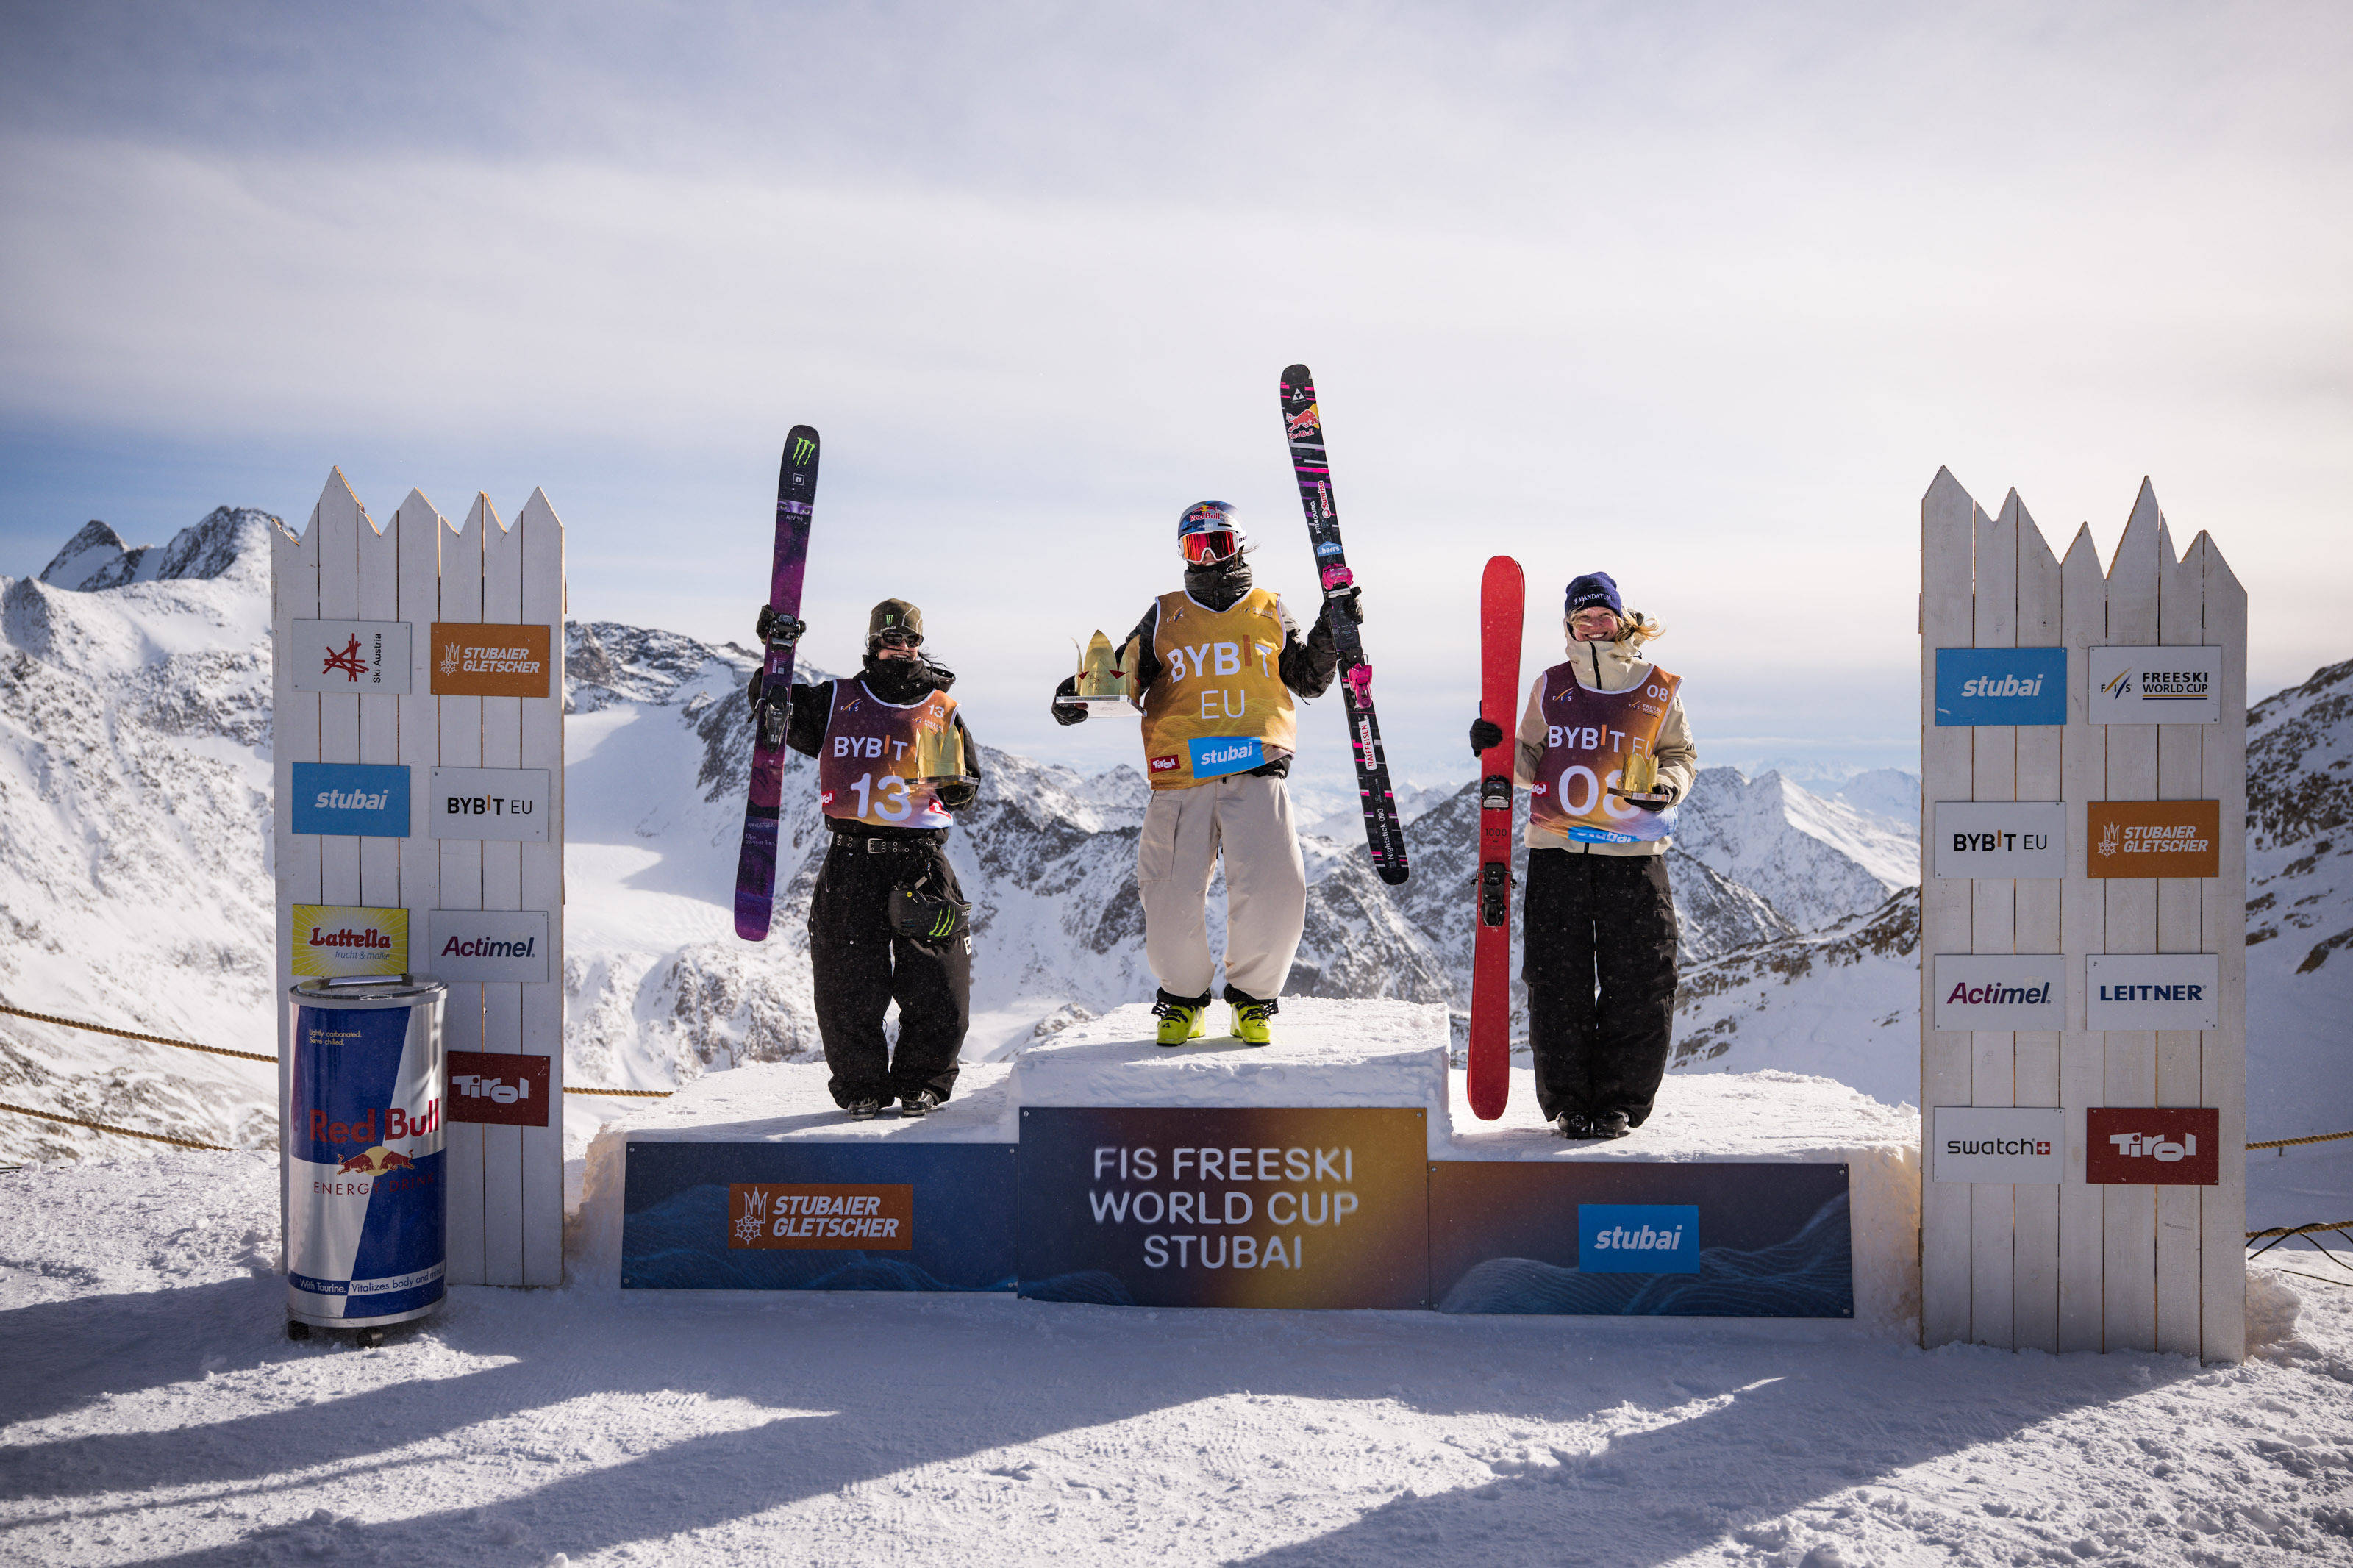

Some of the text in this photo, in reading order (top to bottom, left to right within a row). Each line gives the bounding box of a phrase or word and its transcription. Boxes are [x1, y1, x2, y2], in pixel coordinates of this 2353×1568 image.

[1288, 429, 1314, 439] Red Bull
[1318, 481, 1329, 509] Sunrise
[1190, 512, 1204, 522] Red
[1578, 594, 1611, 602] MANDATUM
[463, 647, 529, 660] STUBAIER
[1167, 634, 1274, 683] BYBIT
[373, 668, 382, 684] Ski
[463, 660, 540, 673] GLETSCHER
[1960, 674, 2044, 698] stubai
[2142, 672, 2208, 683] FREESKI
[2143, 684, 2208, 692] WORLD CUP
[1201, 690, 1246, 719] EU
[1646, 685, 1668, 703] 08
[928, 704, 945, 718] 13
[834, 735, 908, 761] BYBIT
[1362, 724, 1374, 767] RAIFFEISEN
[1548, 724, 1625, 753] BYBIT
[1152, 758, 1176, 769] Tirol
[1201, 742, 1252, 765] stubai
[315, 789, 389, 810] stubai
[447, 795, 532, 815] BYBIT EU
[851, 773, 912, 821] 13
[1377, 808, 1385, 821] 090
[1380, 823, 1394, 860] Nightstick
[1486, 828, 1507, 837] 1000
[1954, 830, 2047, 852] BYBIT EU
[2124, 826, 2197, 840] STUBAIER
[2124, 840, 2208, 853] GLETSCHER
[308, 927, 392, 948] Lattella
[442, 936, 535, 958] Actimel
[335, 949, 390, 960] frucht & molke
[1946, 982, 2050, 1004] Actimel
[2100, 984, 2204, 1001] LEITNER
[309, 1029, 324, 1037] Lightly
[452, 1075, 529, 1103] Tirol
[310, 1098, 440, 1144] Red Bull
[1947, 1138, 2034, 1155] swatch
[2110, 1132, 2196, 1161] Tirol
[1093, 1147, 1353, 1183] FIS FREESKI
[313, 1173, 435, 1195] ENERGY DRINK
[773, 1196, 881, 1216] STUBAIER
[1089, 1189, 1359, 1226] WORLD CUP
[773, 1217, 899, 1238] GLETSCHER
[1594, 1225, 1682, 1250] stubai
[1143, 1234, 1302, 1270] STUBAI
[299, 1278, 315, 1288] With
[317, 1281, 346, 1293] Taurine.
[351, 1281, 390, 1293] Vitalizes
[392, 1278, 413, 1289] body
[416, 1273, 429, 1284] and
